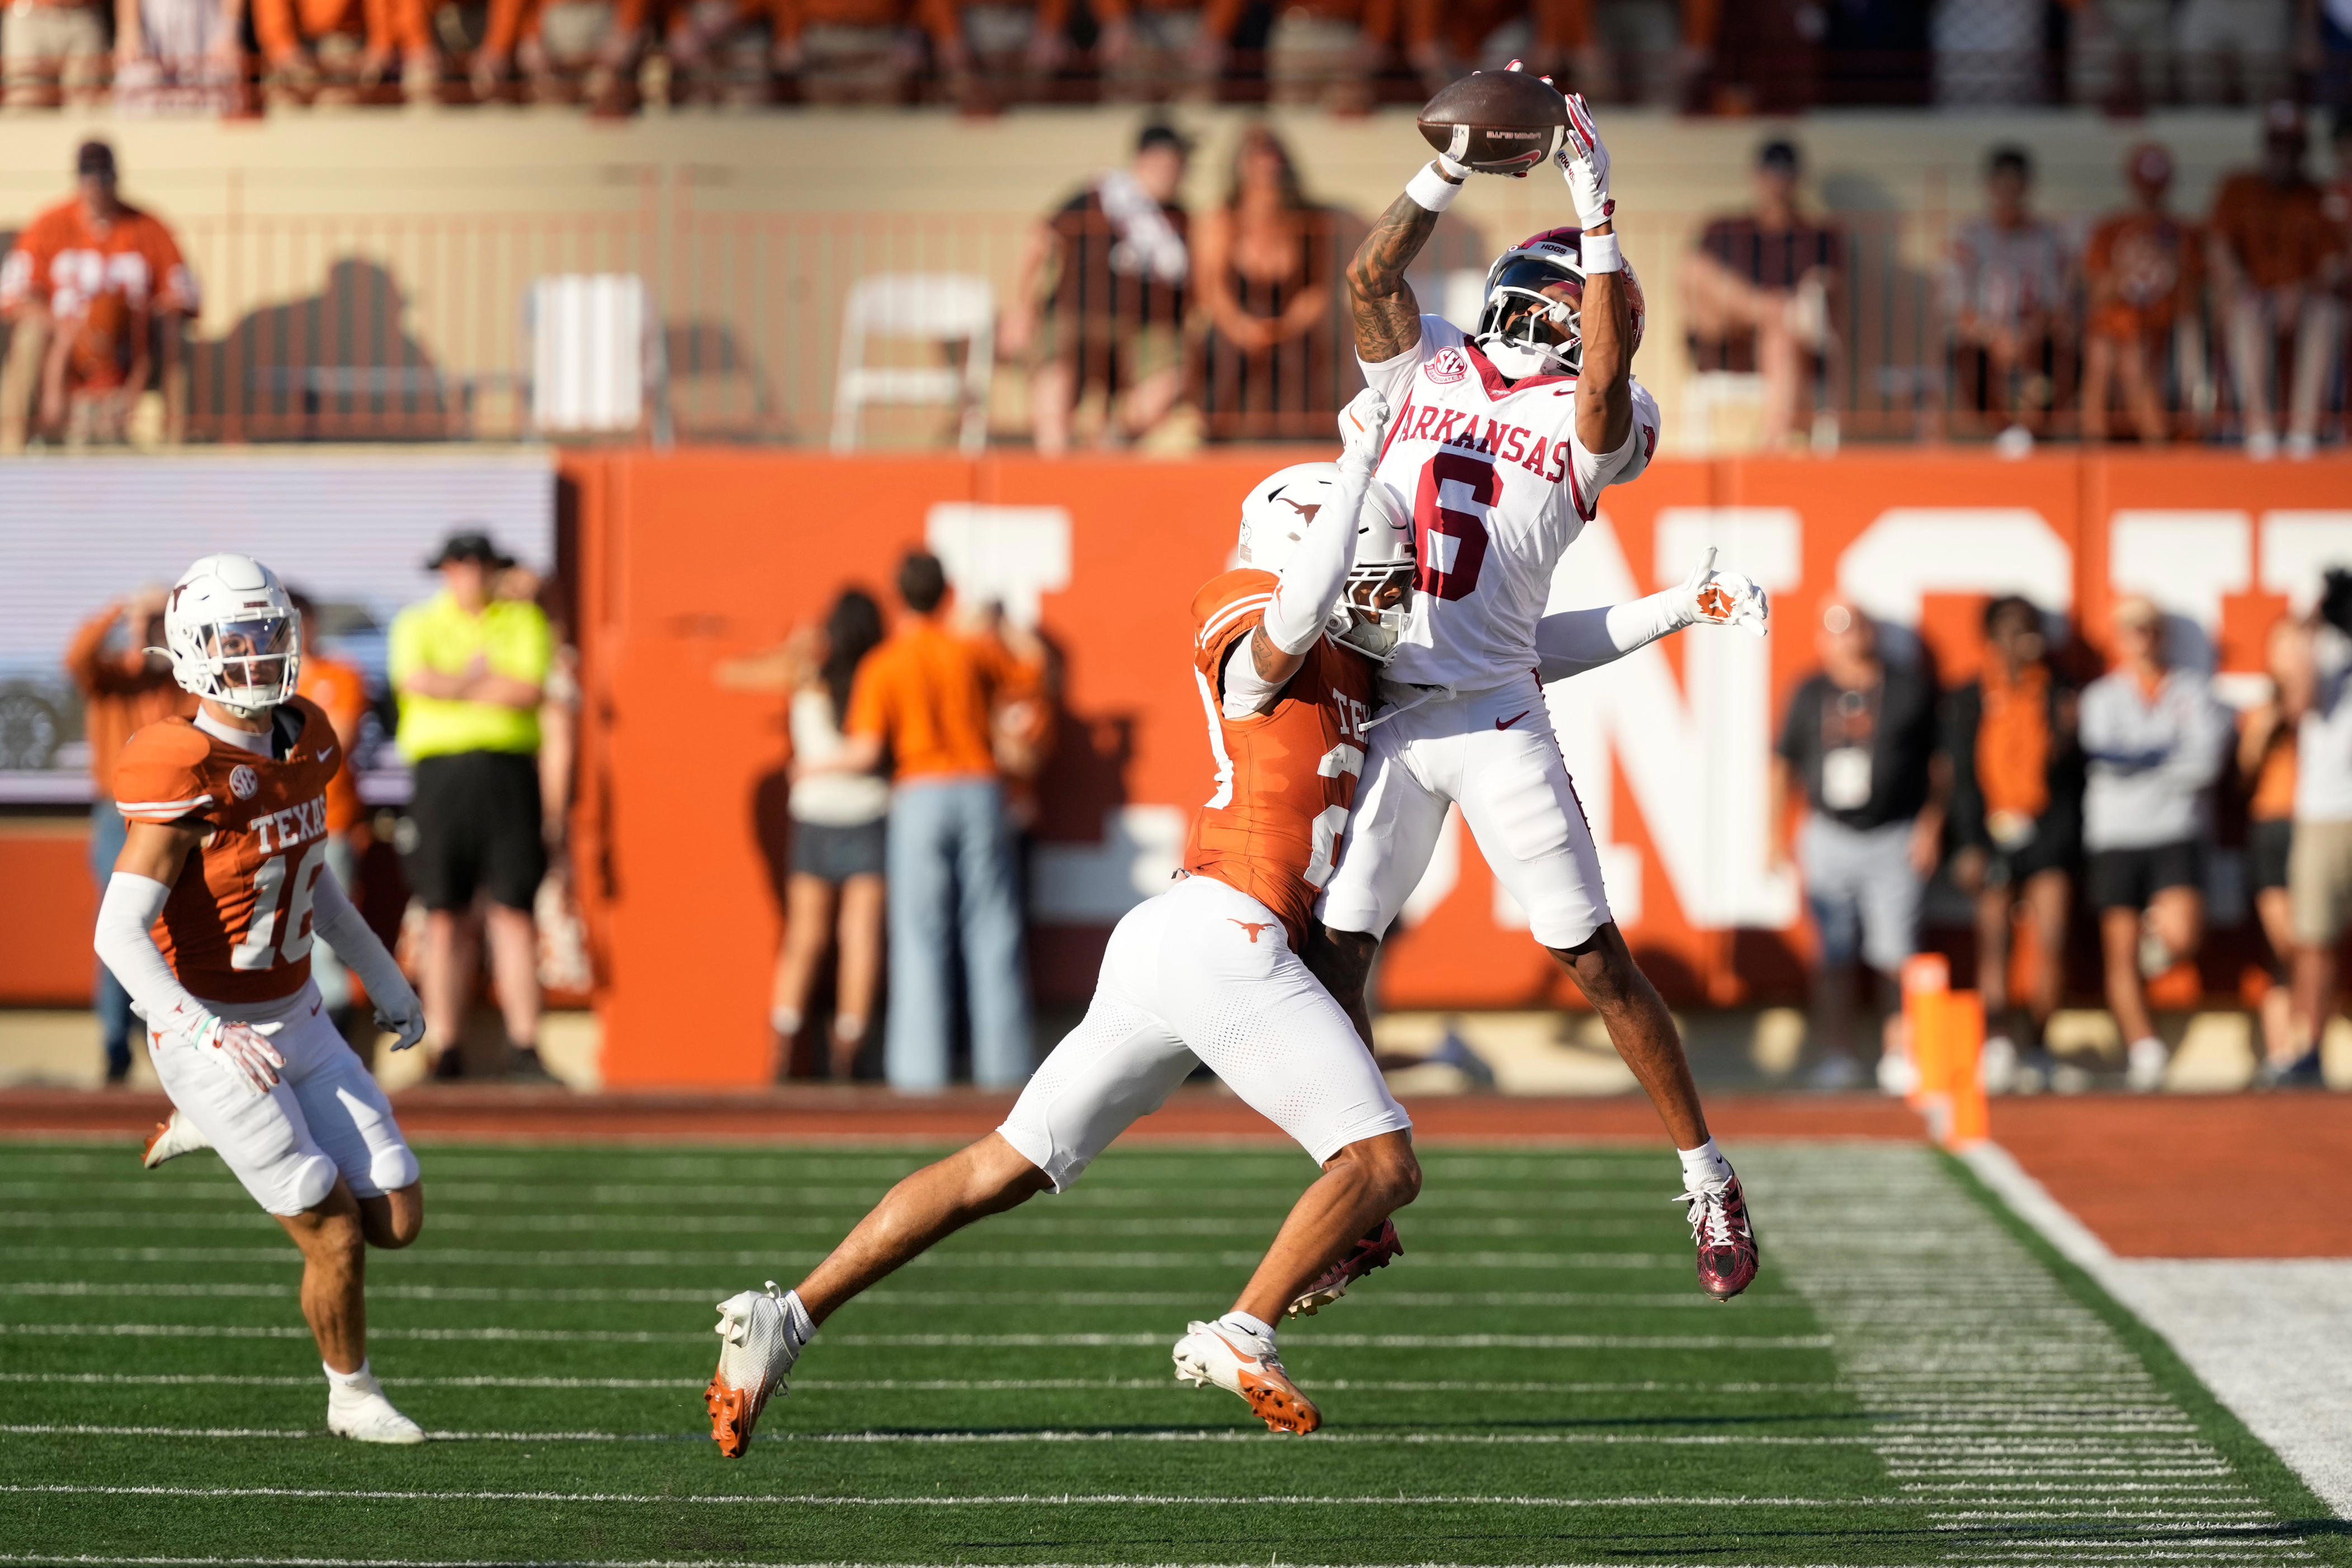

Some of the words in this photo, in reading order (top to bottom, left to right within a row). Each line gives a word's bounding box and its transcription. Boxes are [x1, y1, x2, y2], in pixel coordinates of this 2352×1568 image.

[1486, 130, 1513, 139] ELITE
[1541, 244, 1567, 254] HOGS
[1429, 370, 1455, 382] GRADUATE
[1435, 348, 1464, 374] SEC
[1398, 405, 1567, 484] ARKANSAS
[1412, 451, 1504, 602] 6
[1332, 687, 1371, 745] TEX
[231, 767, 256, 797] SEC
[250, 793, 326, 854] TEXA
[1303, 743, 1365, 889] 2
[230, 837, 328, 971] 16
